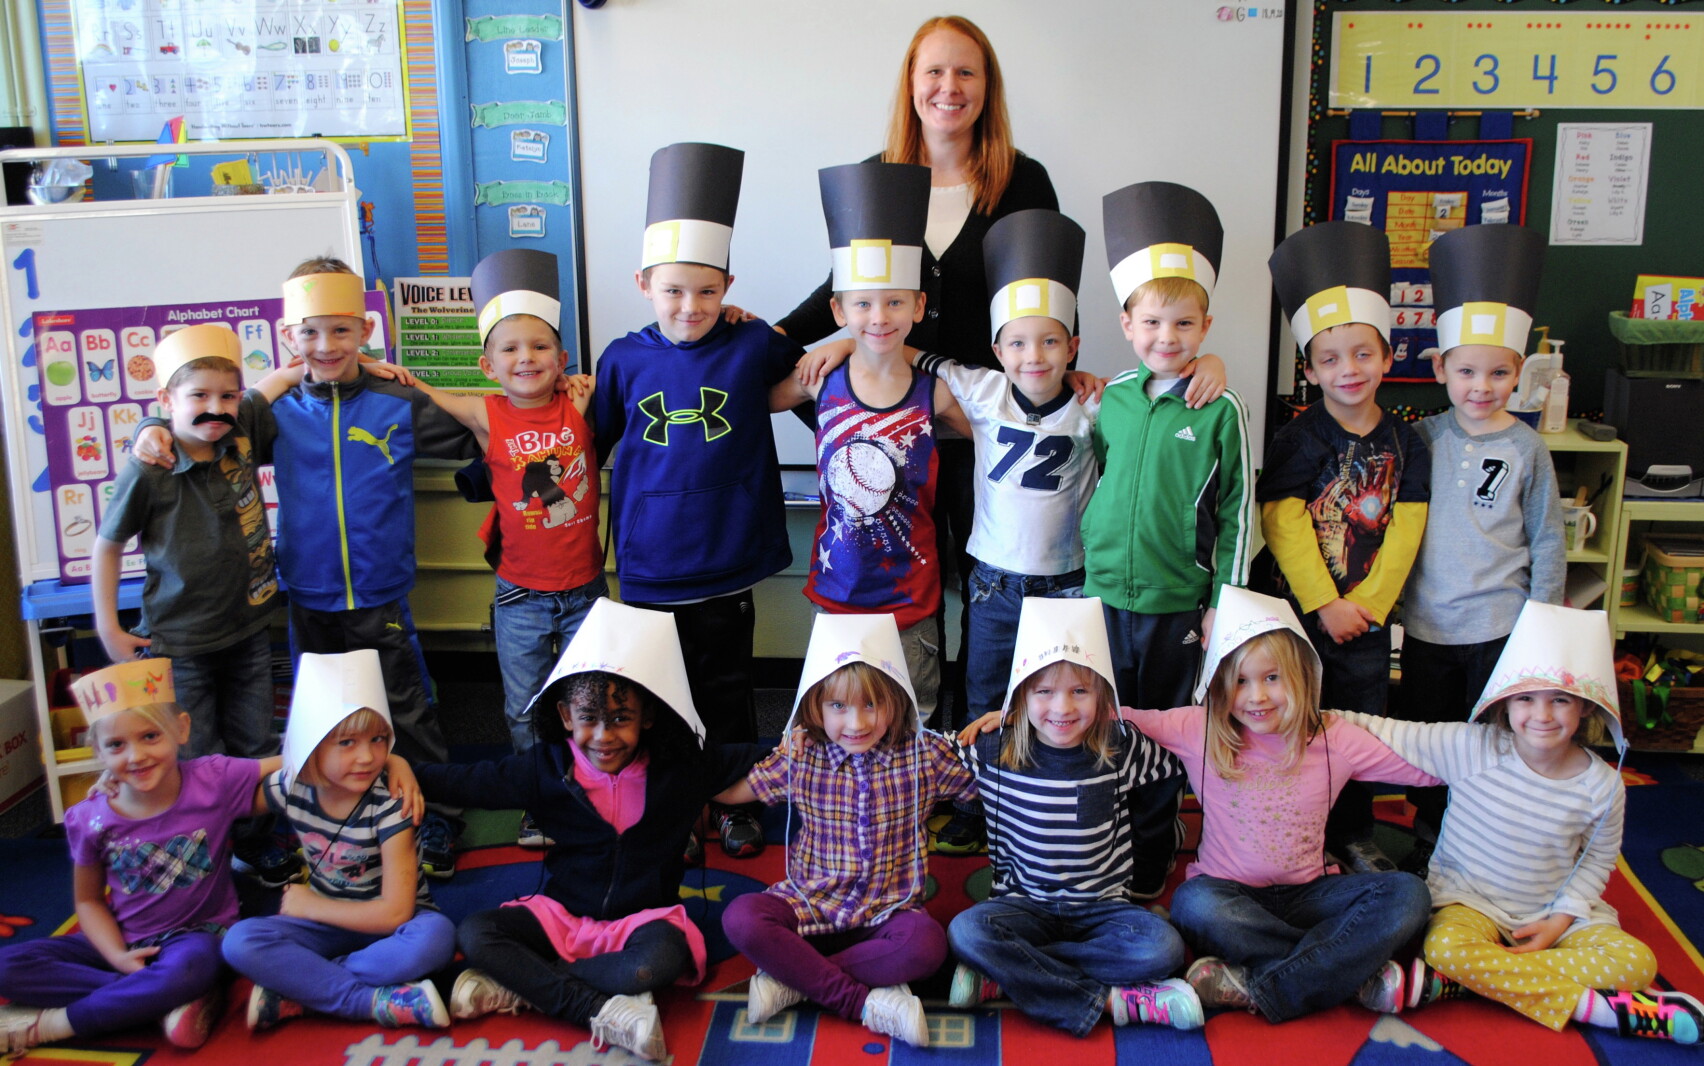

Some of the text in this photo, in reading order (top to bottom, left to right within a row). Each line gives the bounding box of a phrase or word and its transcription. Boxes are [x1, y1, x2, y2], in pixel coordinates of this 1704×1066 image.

[255, 17, 286, 35] Ww
[365, 13, 385, 33] Zz
[1364, 55, 1372, 93] 1
[1413, 54, 1442, 94] 2
[1472, 54, 1499, 94] 3
[1532, 54, 1558, 94] 4
[1590, 54, 1618, 94] 5
[1649, 55, 1676, 95] 6
[1350, 152, 1512, 179] All About Today
[1352, 188, 1370, 197] Days
[13, 248, 40, 299] 1
[400, 283, 444, 306] VOICE
[168, 306, 260, 323] Alphabet Chart
[1396, 311, 1405, 326] 6
[46, 336, 72, 352] Aa
[86, 334, 110, 351] Bb
[127, 332, 150, 348] Cc
[245, 325, 263, 340] Ff
[78, 411, 95, 431] Jj
[113, 409, 138, 424] Kk
[516, 426, 575, 455] BIG
[987, 425, 1075, 491] 72
[1476, 458, 1509, 501] 7
[64, 489, 85, 505] Rr
[4, 729, 28, 755] BOX
